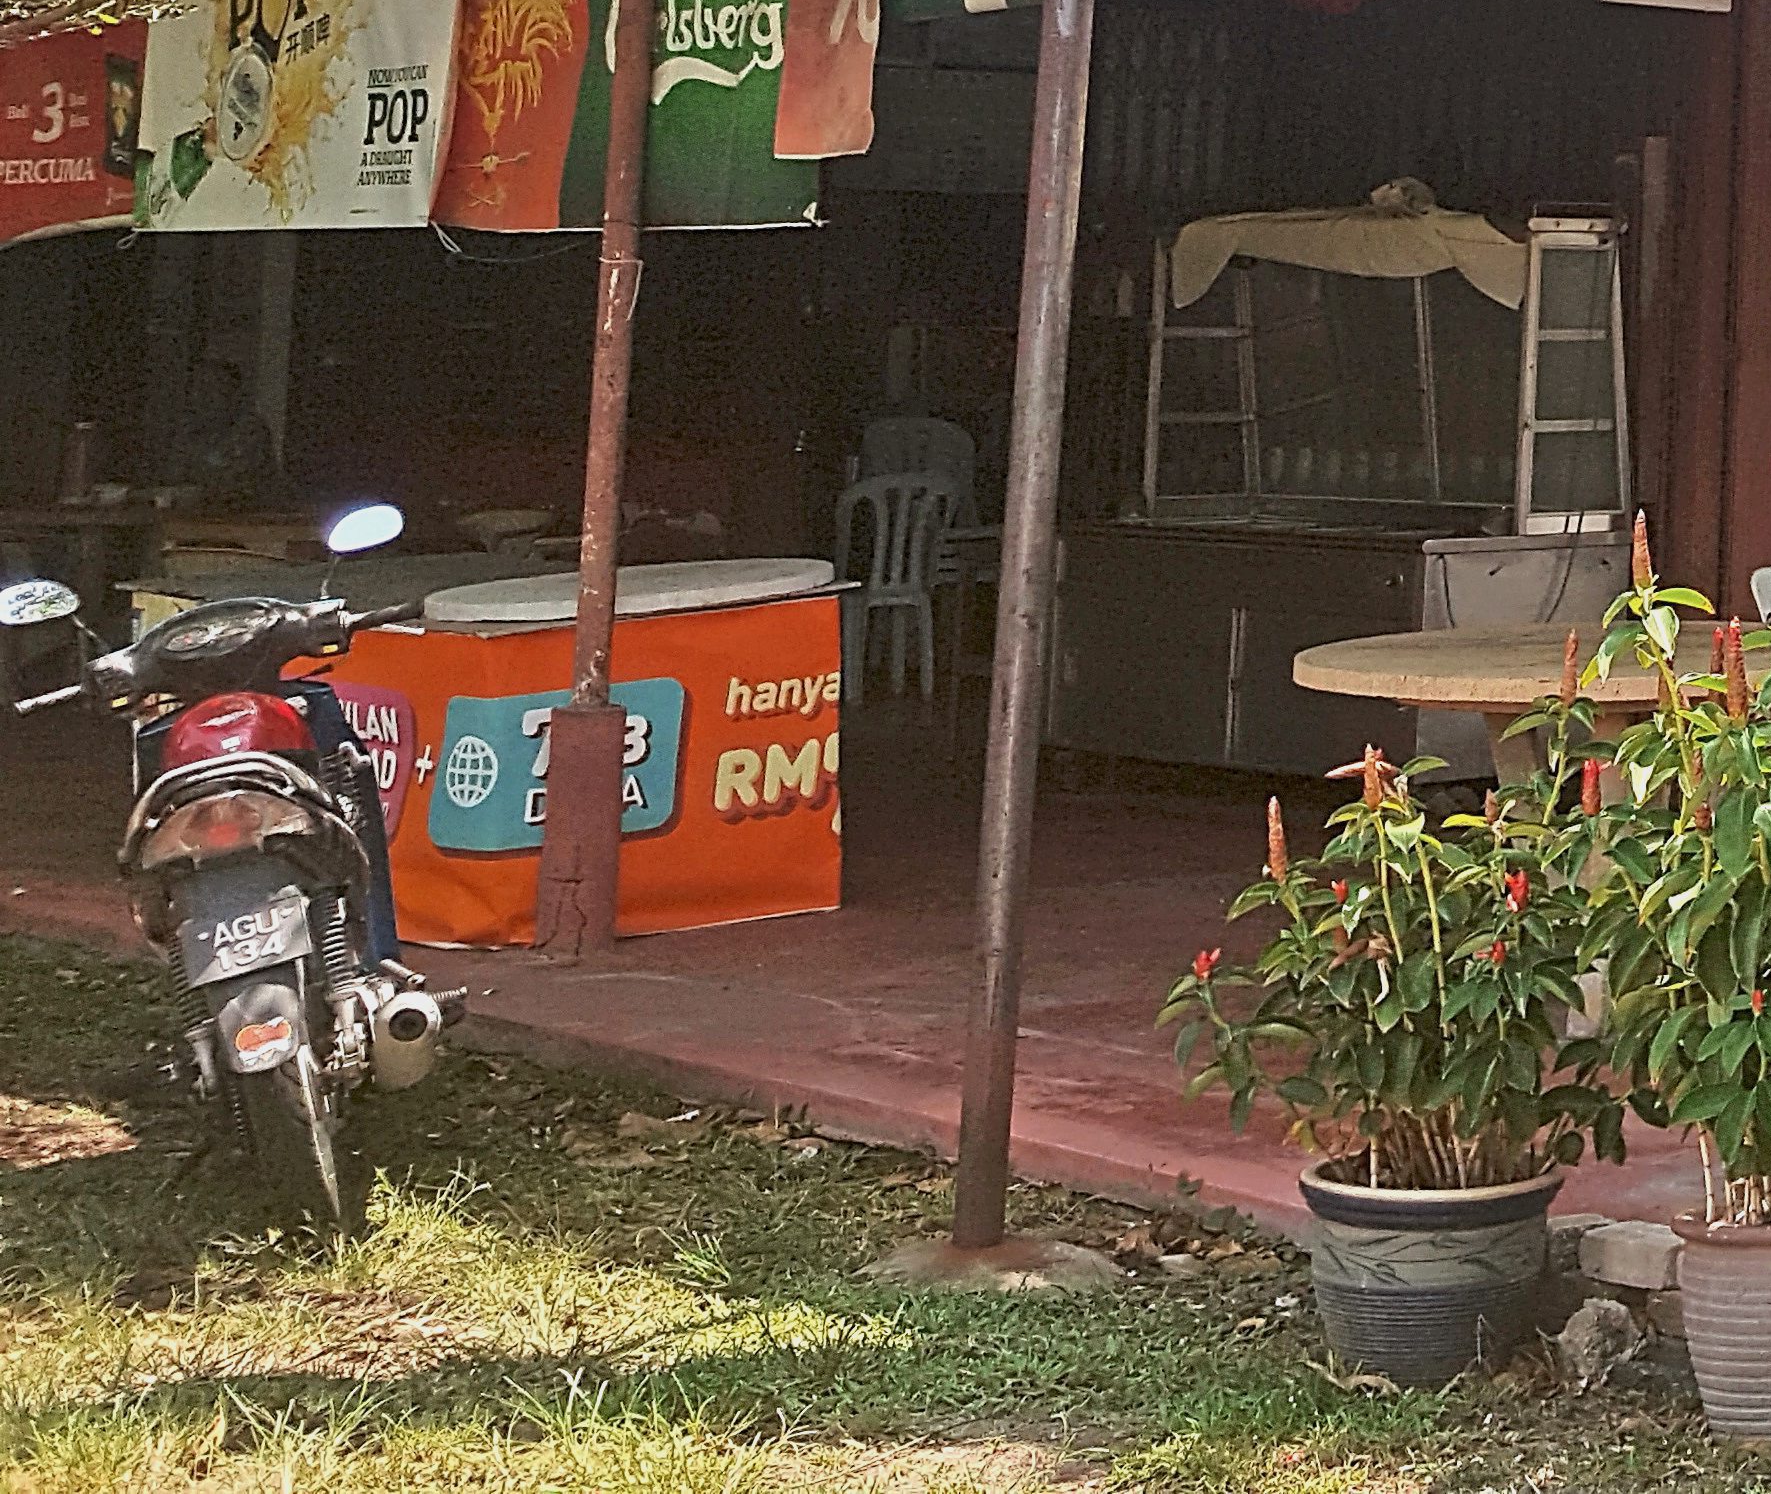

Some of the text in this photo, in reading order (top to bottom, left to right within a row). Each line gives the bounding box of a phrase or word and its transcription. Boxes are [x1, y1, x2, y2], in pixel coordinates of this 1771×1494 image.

[32, 81, 64, 144] 3
[363, 89, 428, 145] POP
[725, 670, 841, 716] hanya
[213, 908, 281, 948] AGU
[216, 930, 287, 970] 134
